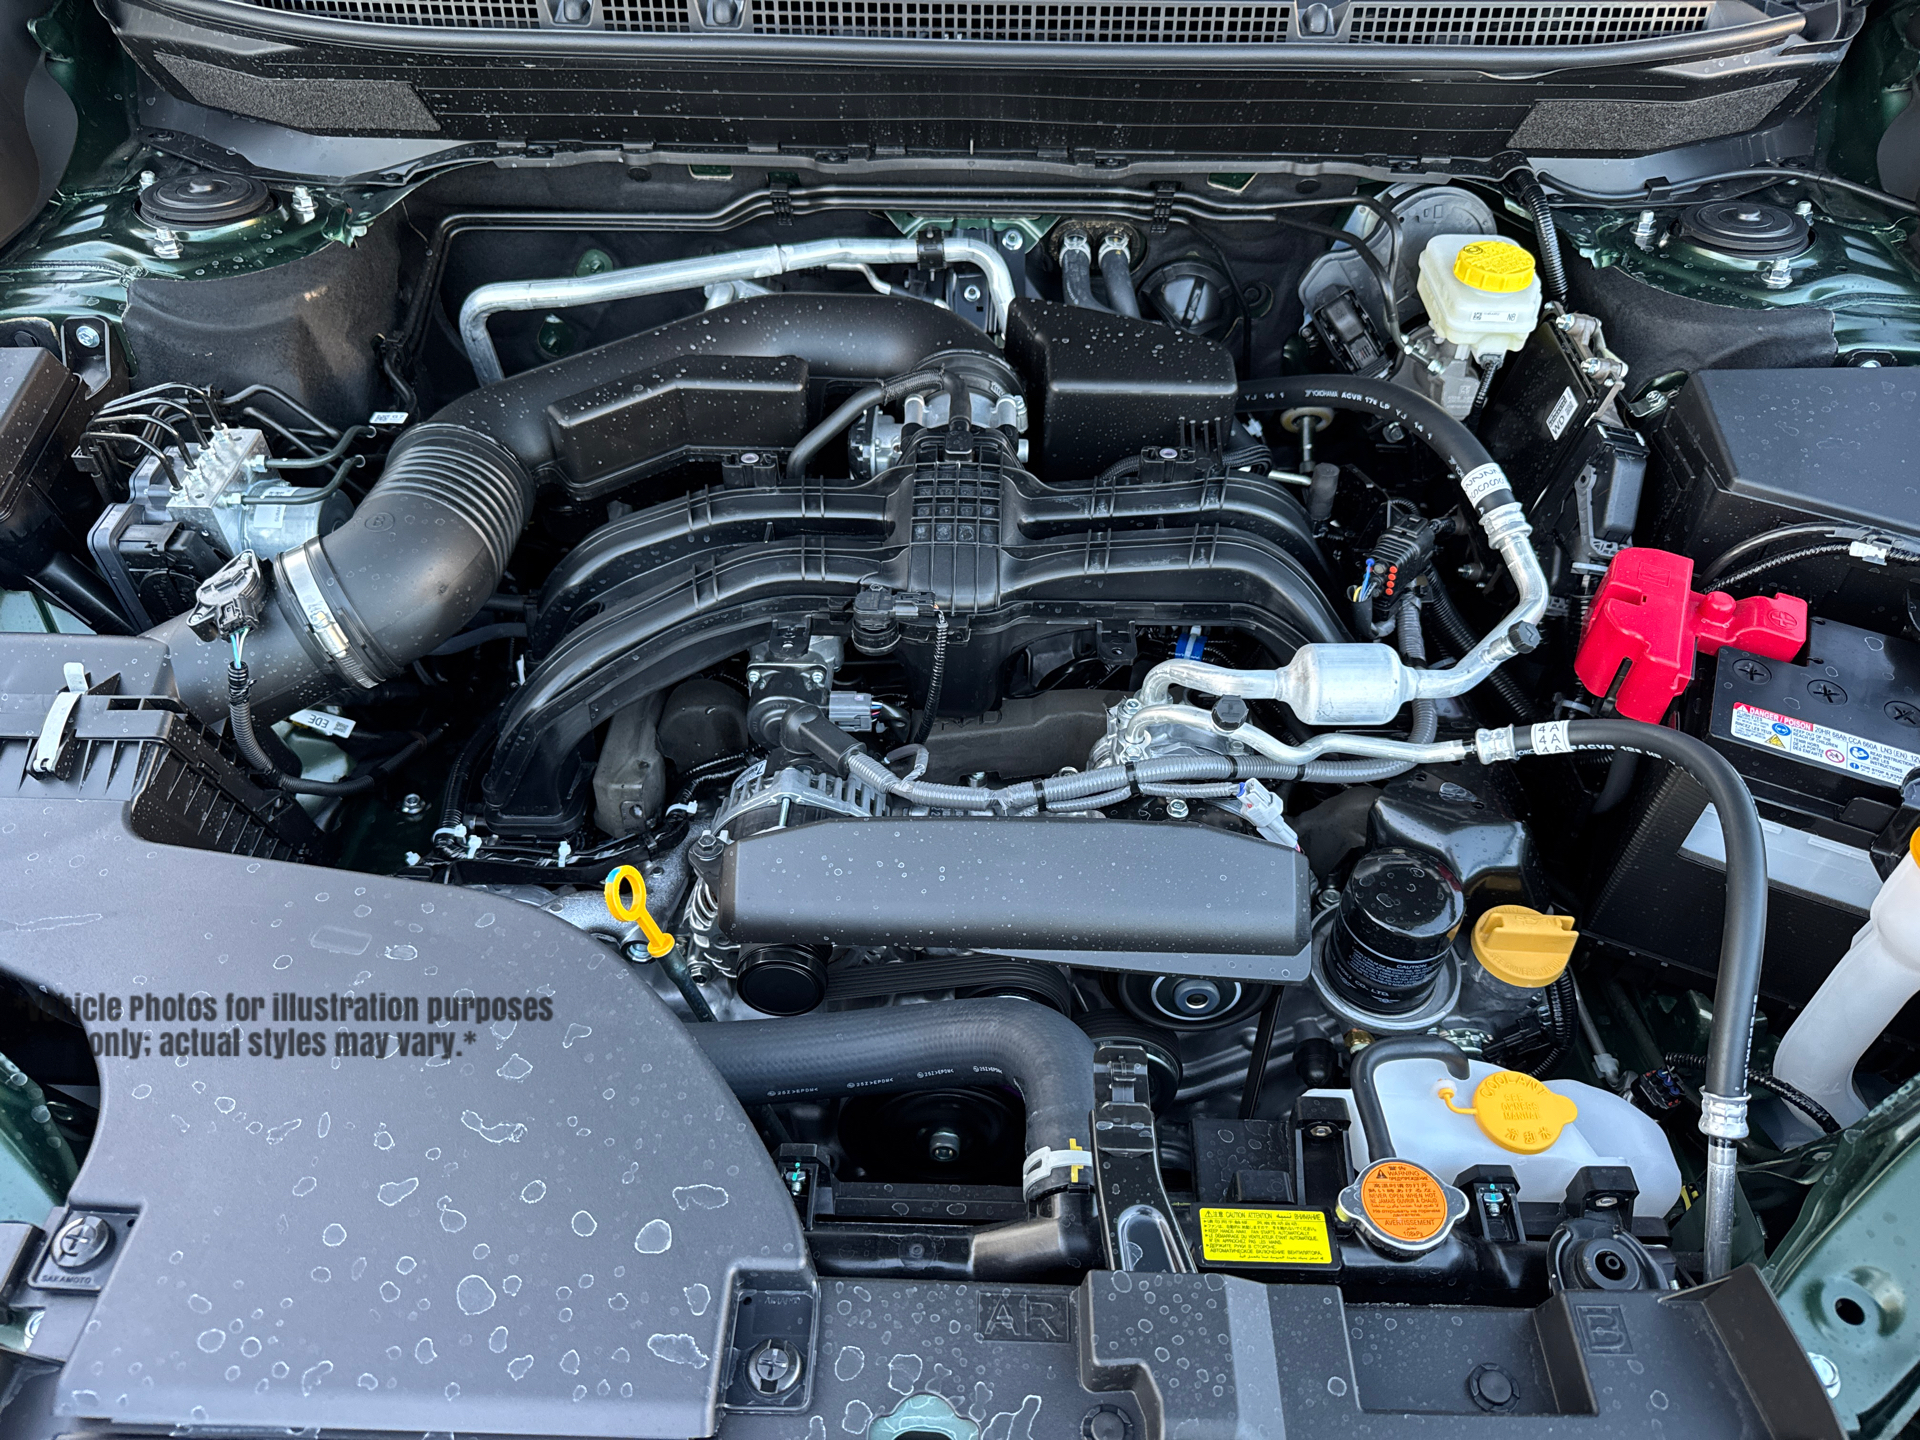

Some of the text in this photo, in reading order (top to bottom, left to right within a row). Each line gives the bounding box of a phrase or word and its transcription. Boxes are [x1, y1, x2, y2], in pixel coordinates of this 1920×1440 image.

[1750, 707, 1779, 722] DANGER
[1783, 716, 1811, 731] POISON
[1848, 737, 1861, 746] CCA
[1880, 745, 1892, 754] LN3
[1480, 1073, 1550, 1098] COOLANT
[1503, 1094, 1523, 1102] SEE
[1501, 1102, 1539, 1111] OWNERS
[1503, 1111, 1540, 1120] MANUAL
[41, 1274, 92, 1284] SAKAMOTO
[984, 1295, 1064, 1337] AR
